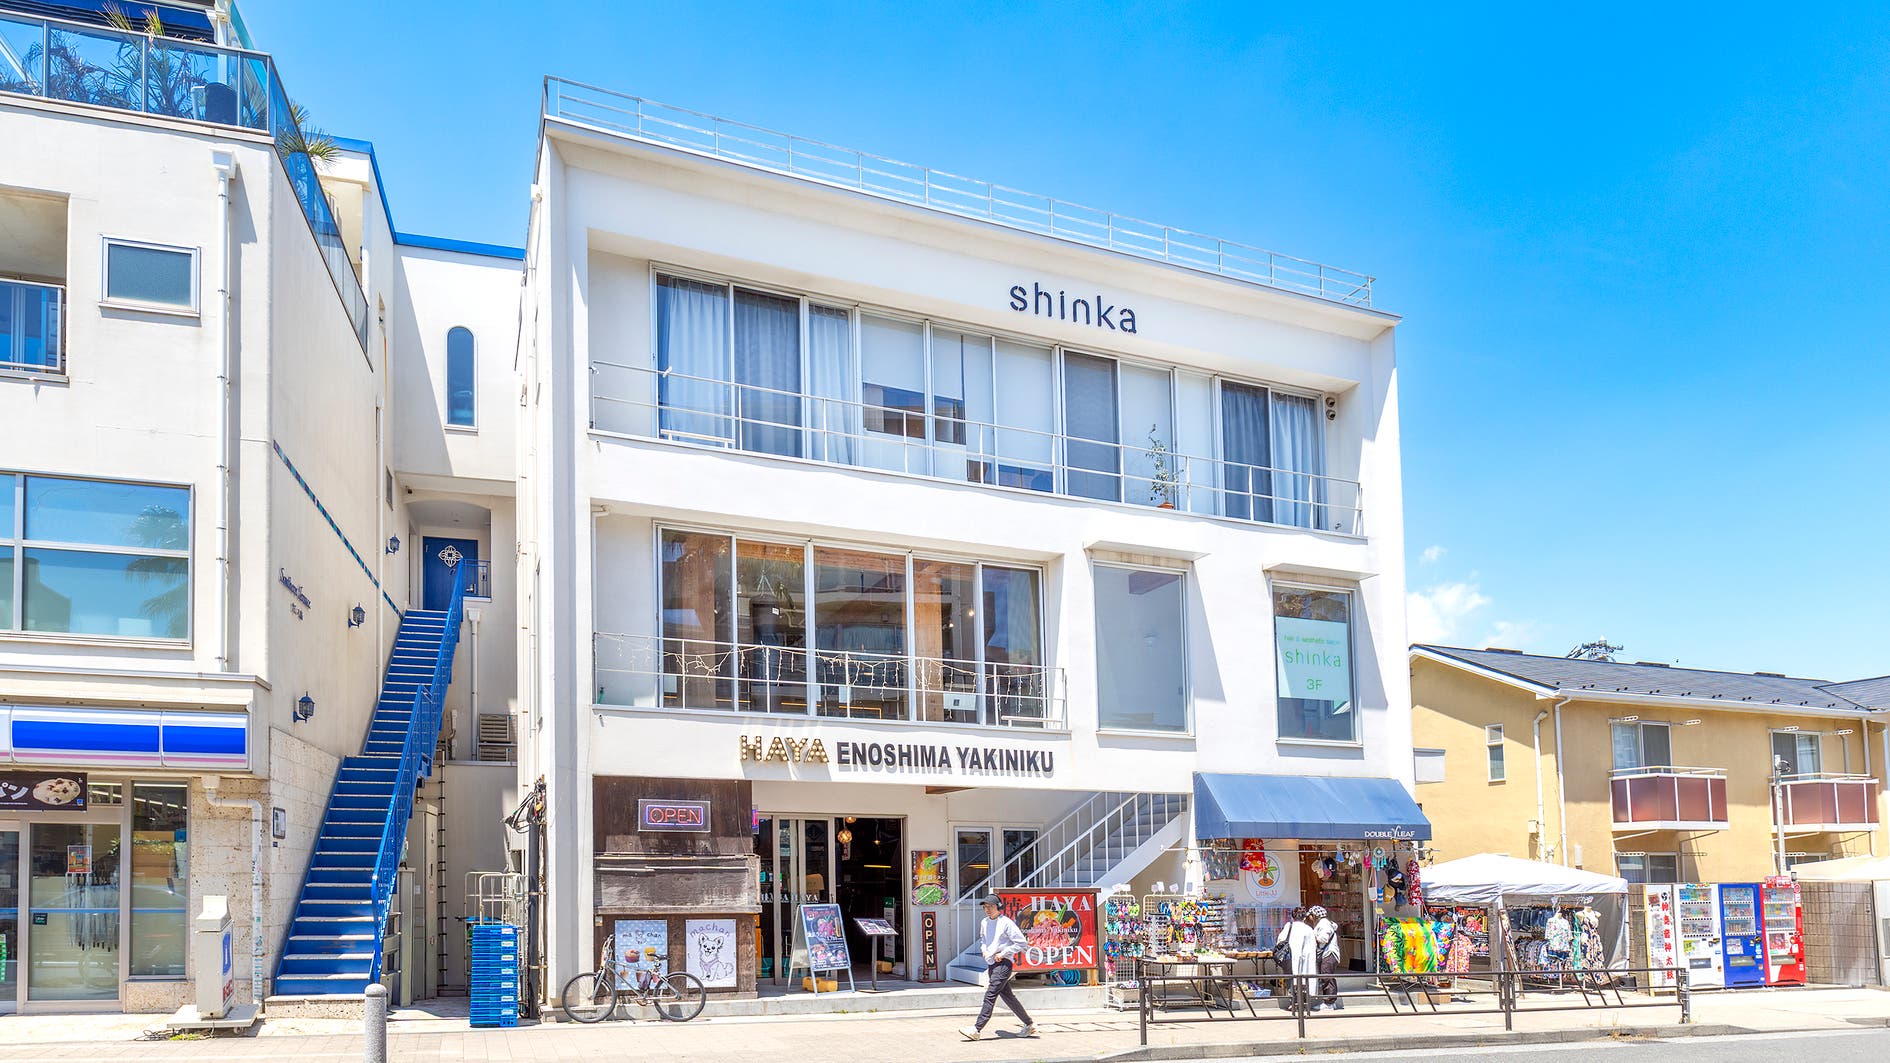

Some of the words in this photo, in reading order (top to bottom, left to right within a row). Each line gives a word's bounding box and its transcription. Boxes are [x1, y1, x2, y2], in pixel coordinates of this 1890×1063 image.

[1009, 282, 1137, 334] shinka
[1285, 649, 1341, 667] shinka
[1306, 678, 1322, 690] 3F
[739, 735, 829, 763] HAYA
[837, 741, 951, 769] ENOSHIMA
[955, 746, 1053, 773] YAKINIKU
[649, 807, 701, 823] OPEN
[1364, 830, 1391, 838] DOUBLE
[1398, 830, 1415, 838] LEAF
[1030, 896, 1092, 912] HAYA
[689, 922, 731, 938] machan
[924, 917, 934, 964] OPEN
[1025, 944, 1095, 966] OPEN
